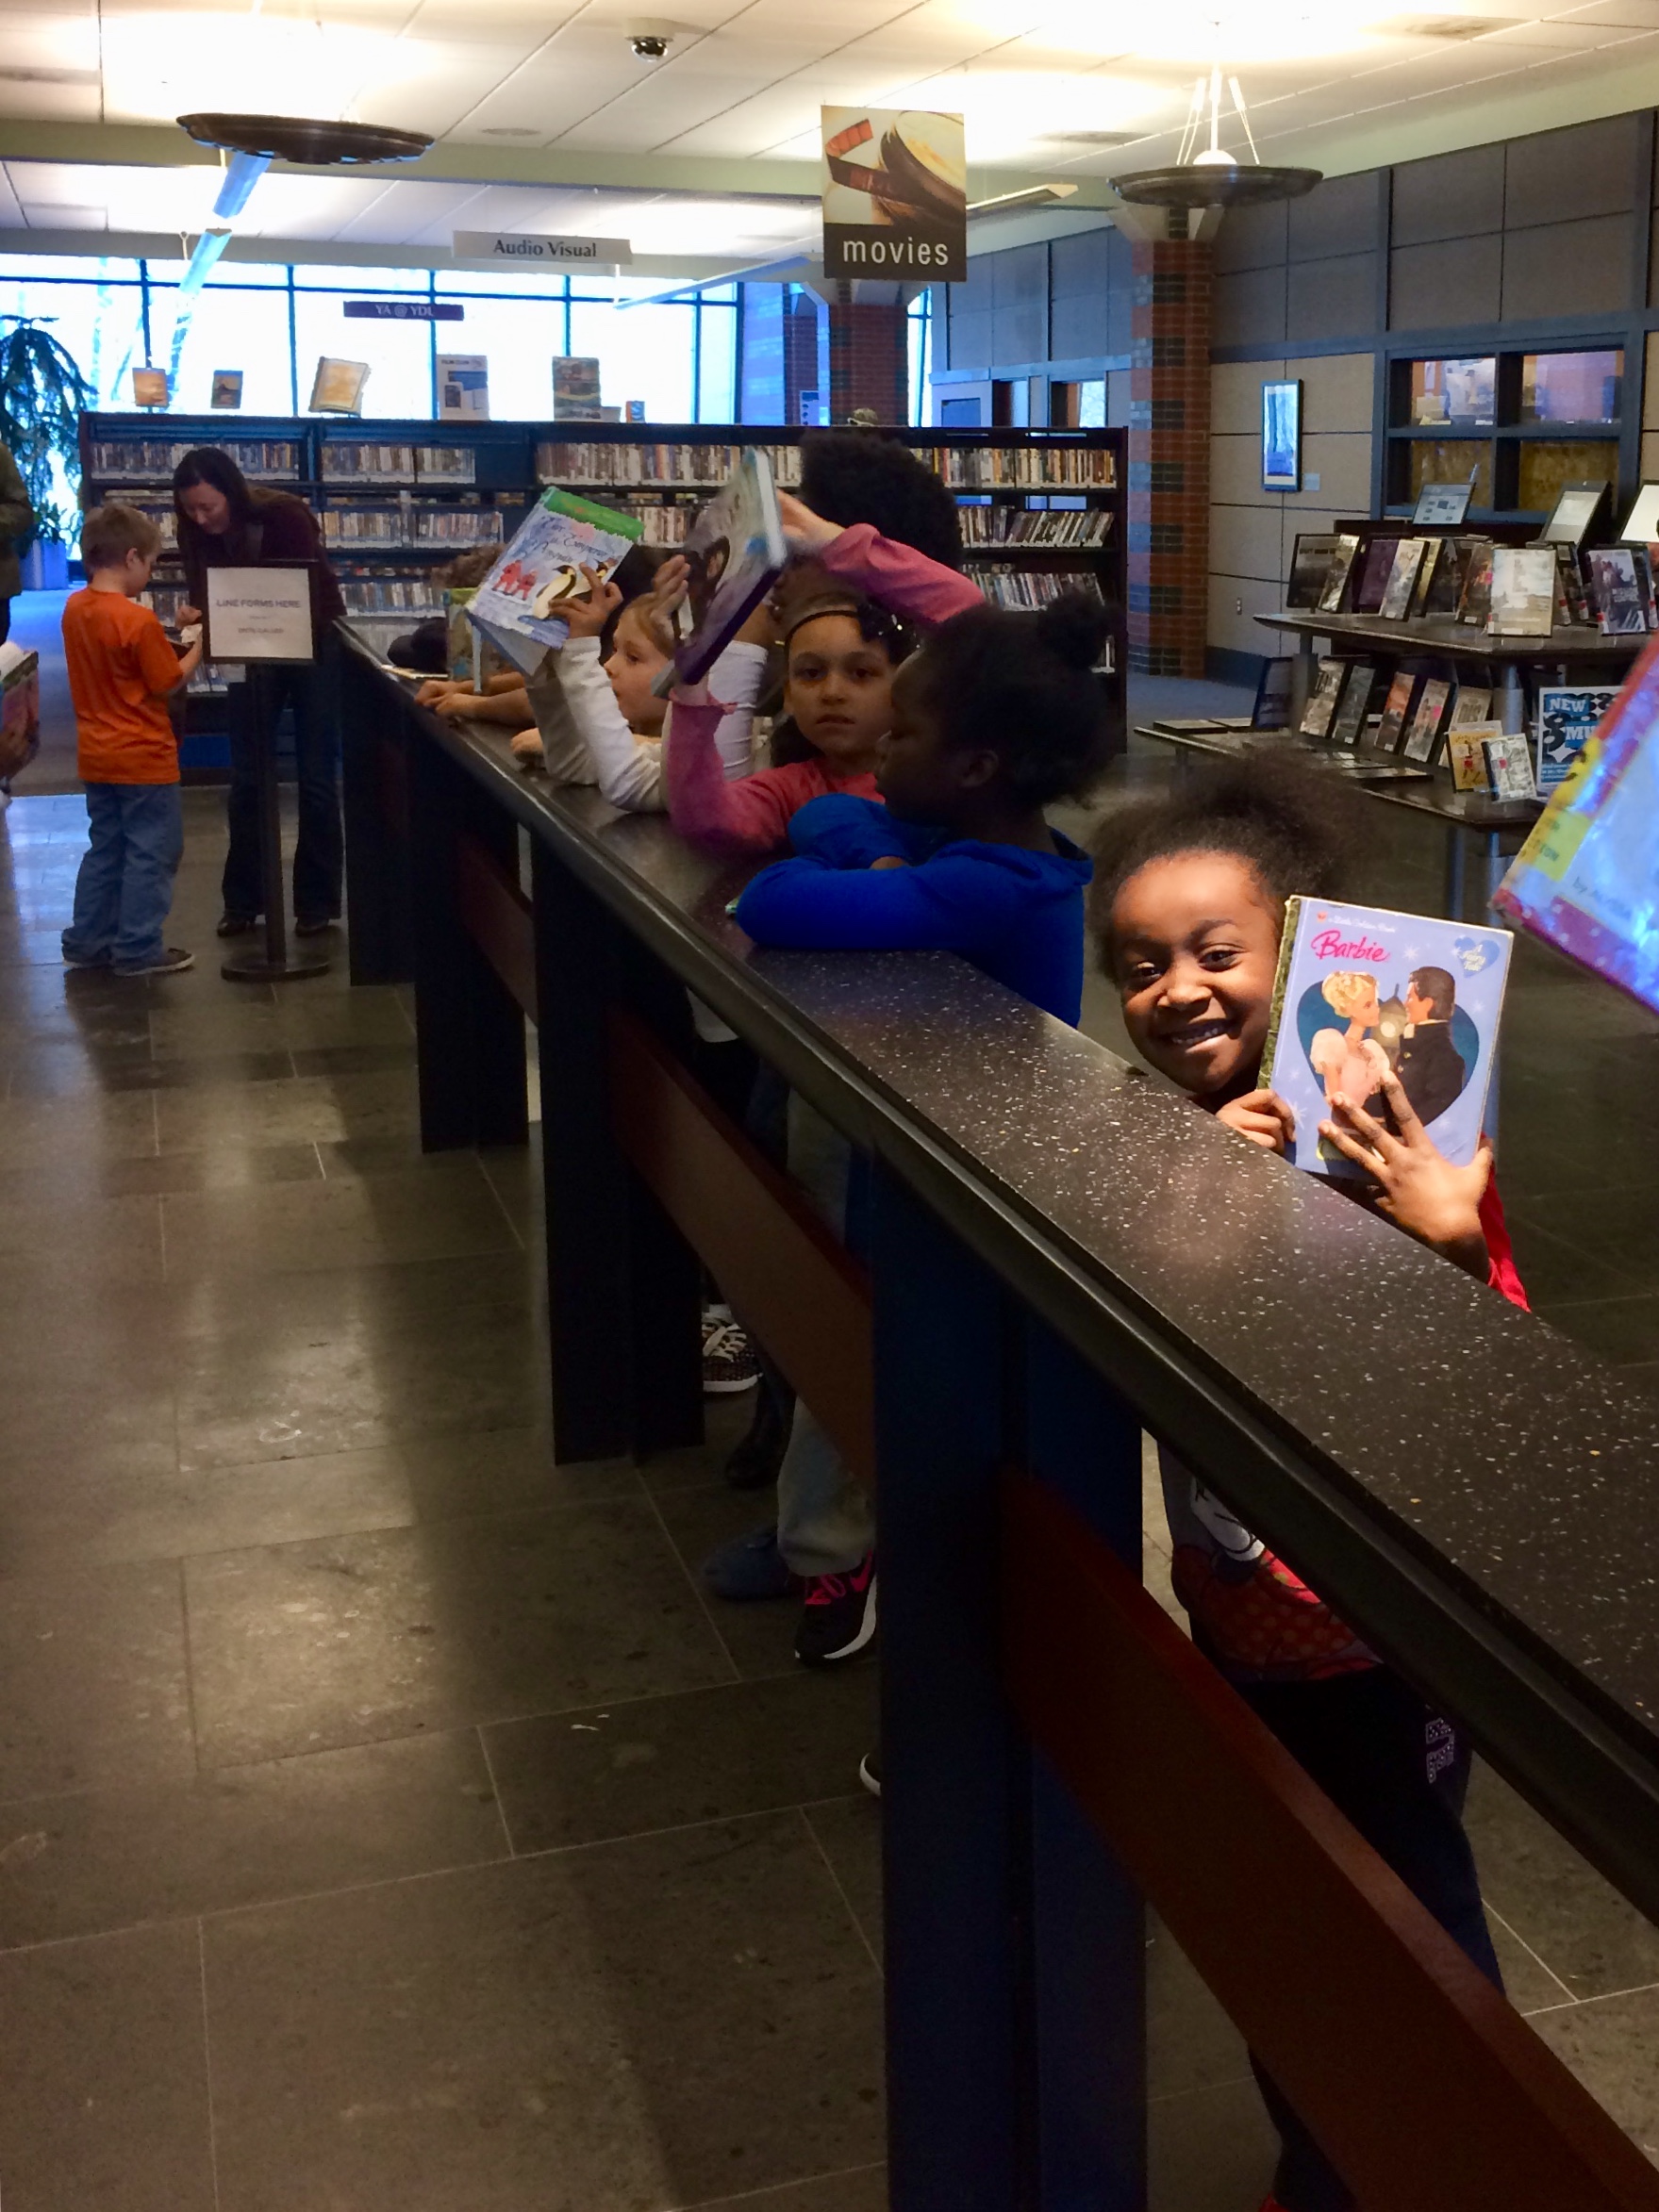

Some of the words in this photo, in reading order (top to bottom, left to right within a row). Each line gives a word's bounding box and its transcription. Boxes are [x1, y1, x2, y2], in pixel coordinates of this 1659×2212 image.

[493, 239, 543, 256] Audio
[547, 241, 597, 257] Visual
[843, 236, 949, 266] movies
[375, 305, 391, 315] YA
[216, 599, 240, 607] LINE
[241, 599, 274, 608] FORMS
[274, 600, 301, 608] HERE
[1549, 698, 1586, 713] NEW
[1310, 929, 1391, 963] Barbie
